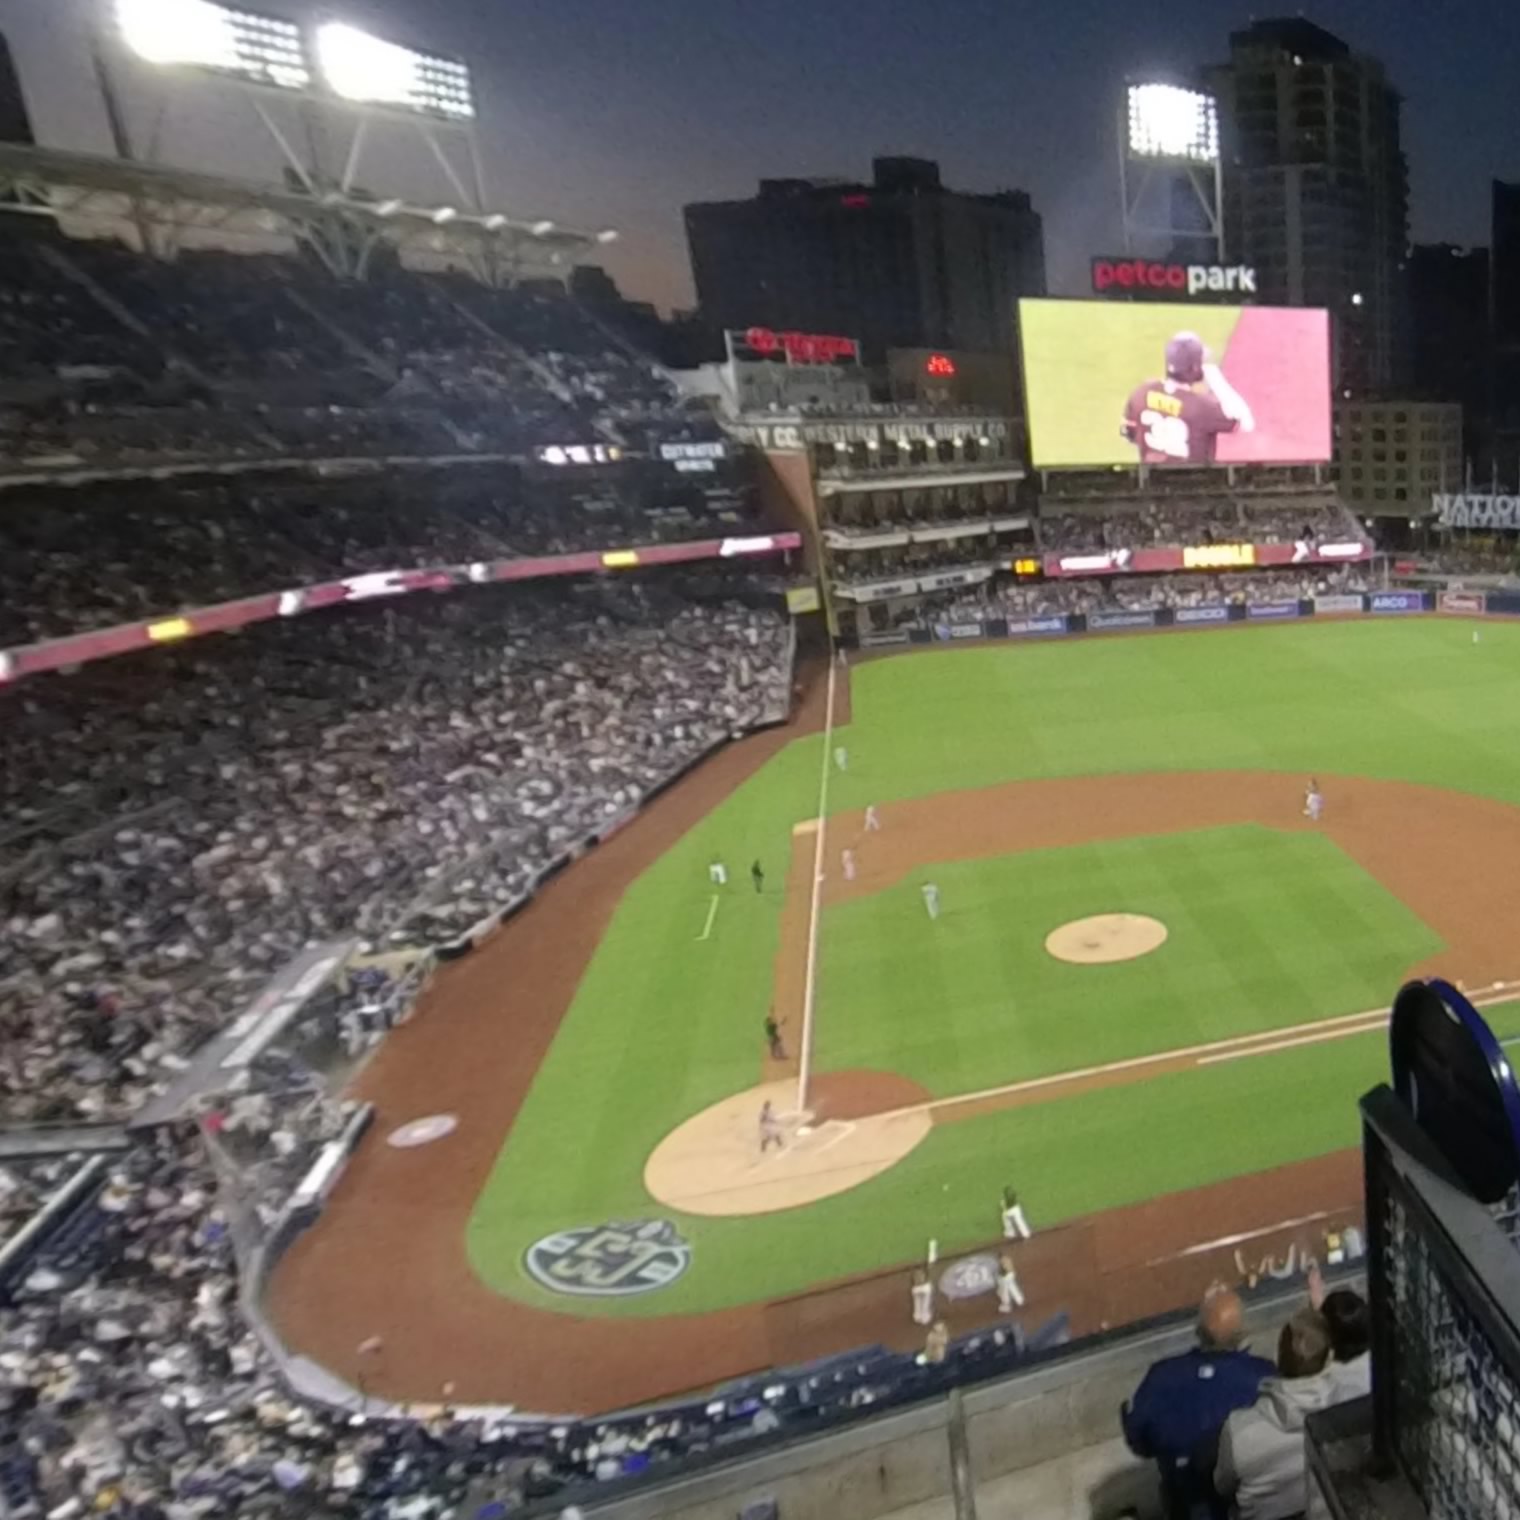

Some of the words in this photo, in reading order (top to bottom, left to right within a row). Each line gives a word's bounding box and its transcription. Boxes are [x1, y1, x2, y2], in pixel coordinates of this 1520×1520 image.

[803, 423, 881, 446] WESTERN
[883, 422, 933, 444] METAL
[1183, 544, 1253, 569] DOUBLE
[1373, 596, 1408, 609] ARCO
[1089, 612, 1155, 628] Qualcomm
